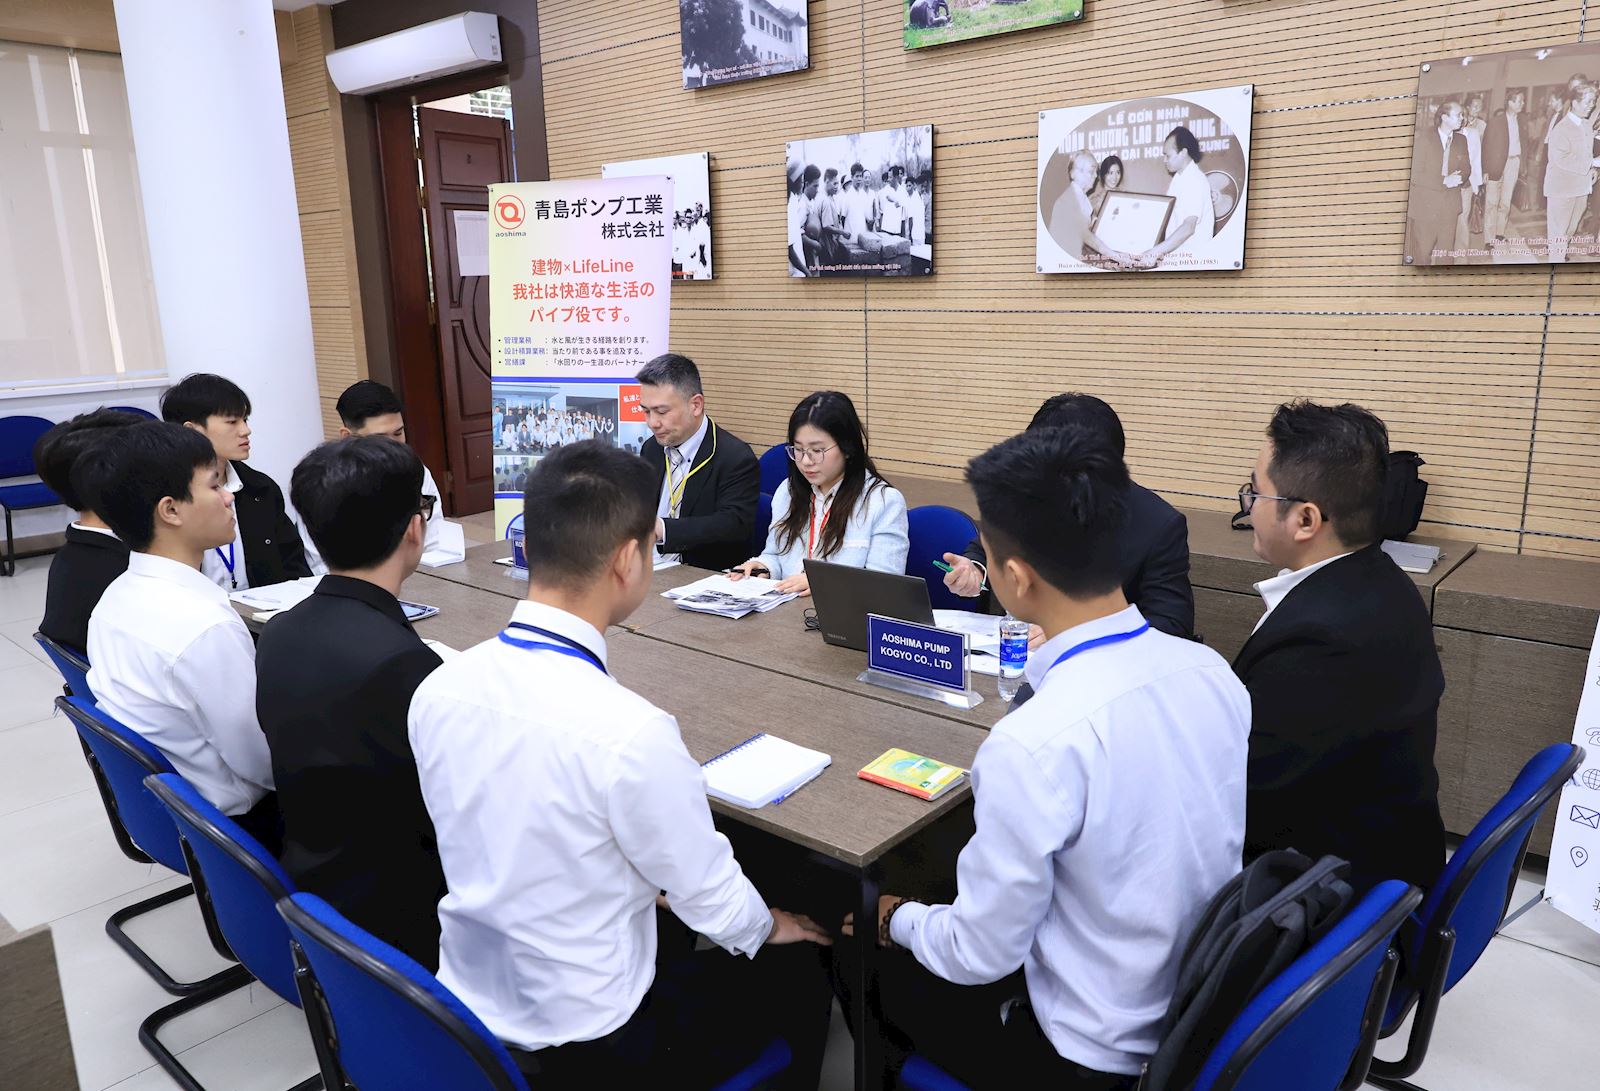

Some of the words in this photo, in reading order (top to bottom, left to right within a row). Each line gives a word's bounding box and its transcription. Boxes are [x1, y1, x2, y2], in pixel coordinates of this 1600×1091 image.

[1156, 105, 1190, 120] NHẬN
[1132, 124, 1152, 145] LAO
[534, 194, 663, 220] 青島ポンプ工業
[602, 220, 664, 240] 株式会社
[532, 258, 634, 276] 建物×LifeLine
[512, 281, 655, 300] 我社は快適な生活の
[530, 306, 630, 323] パイプ役です。
[881, 632, 922, 650] AOSHIMA
[924, 642, 950, 654] PUMP
[880, 646, 912, 661] KOGYO
[914, 654, 932, 667] CO.,
[934, 659, 952, 670] LTD
